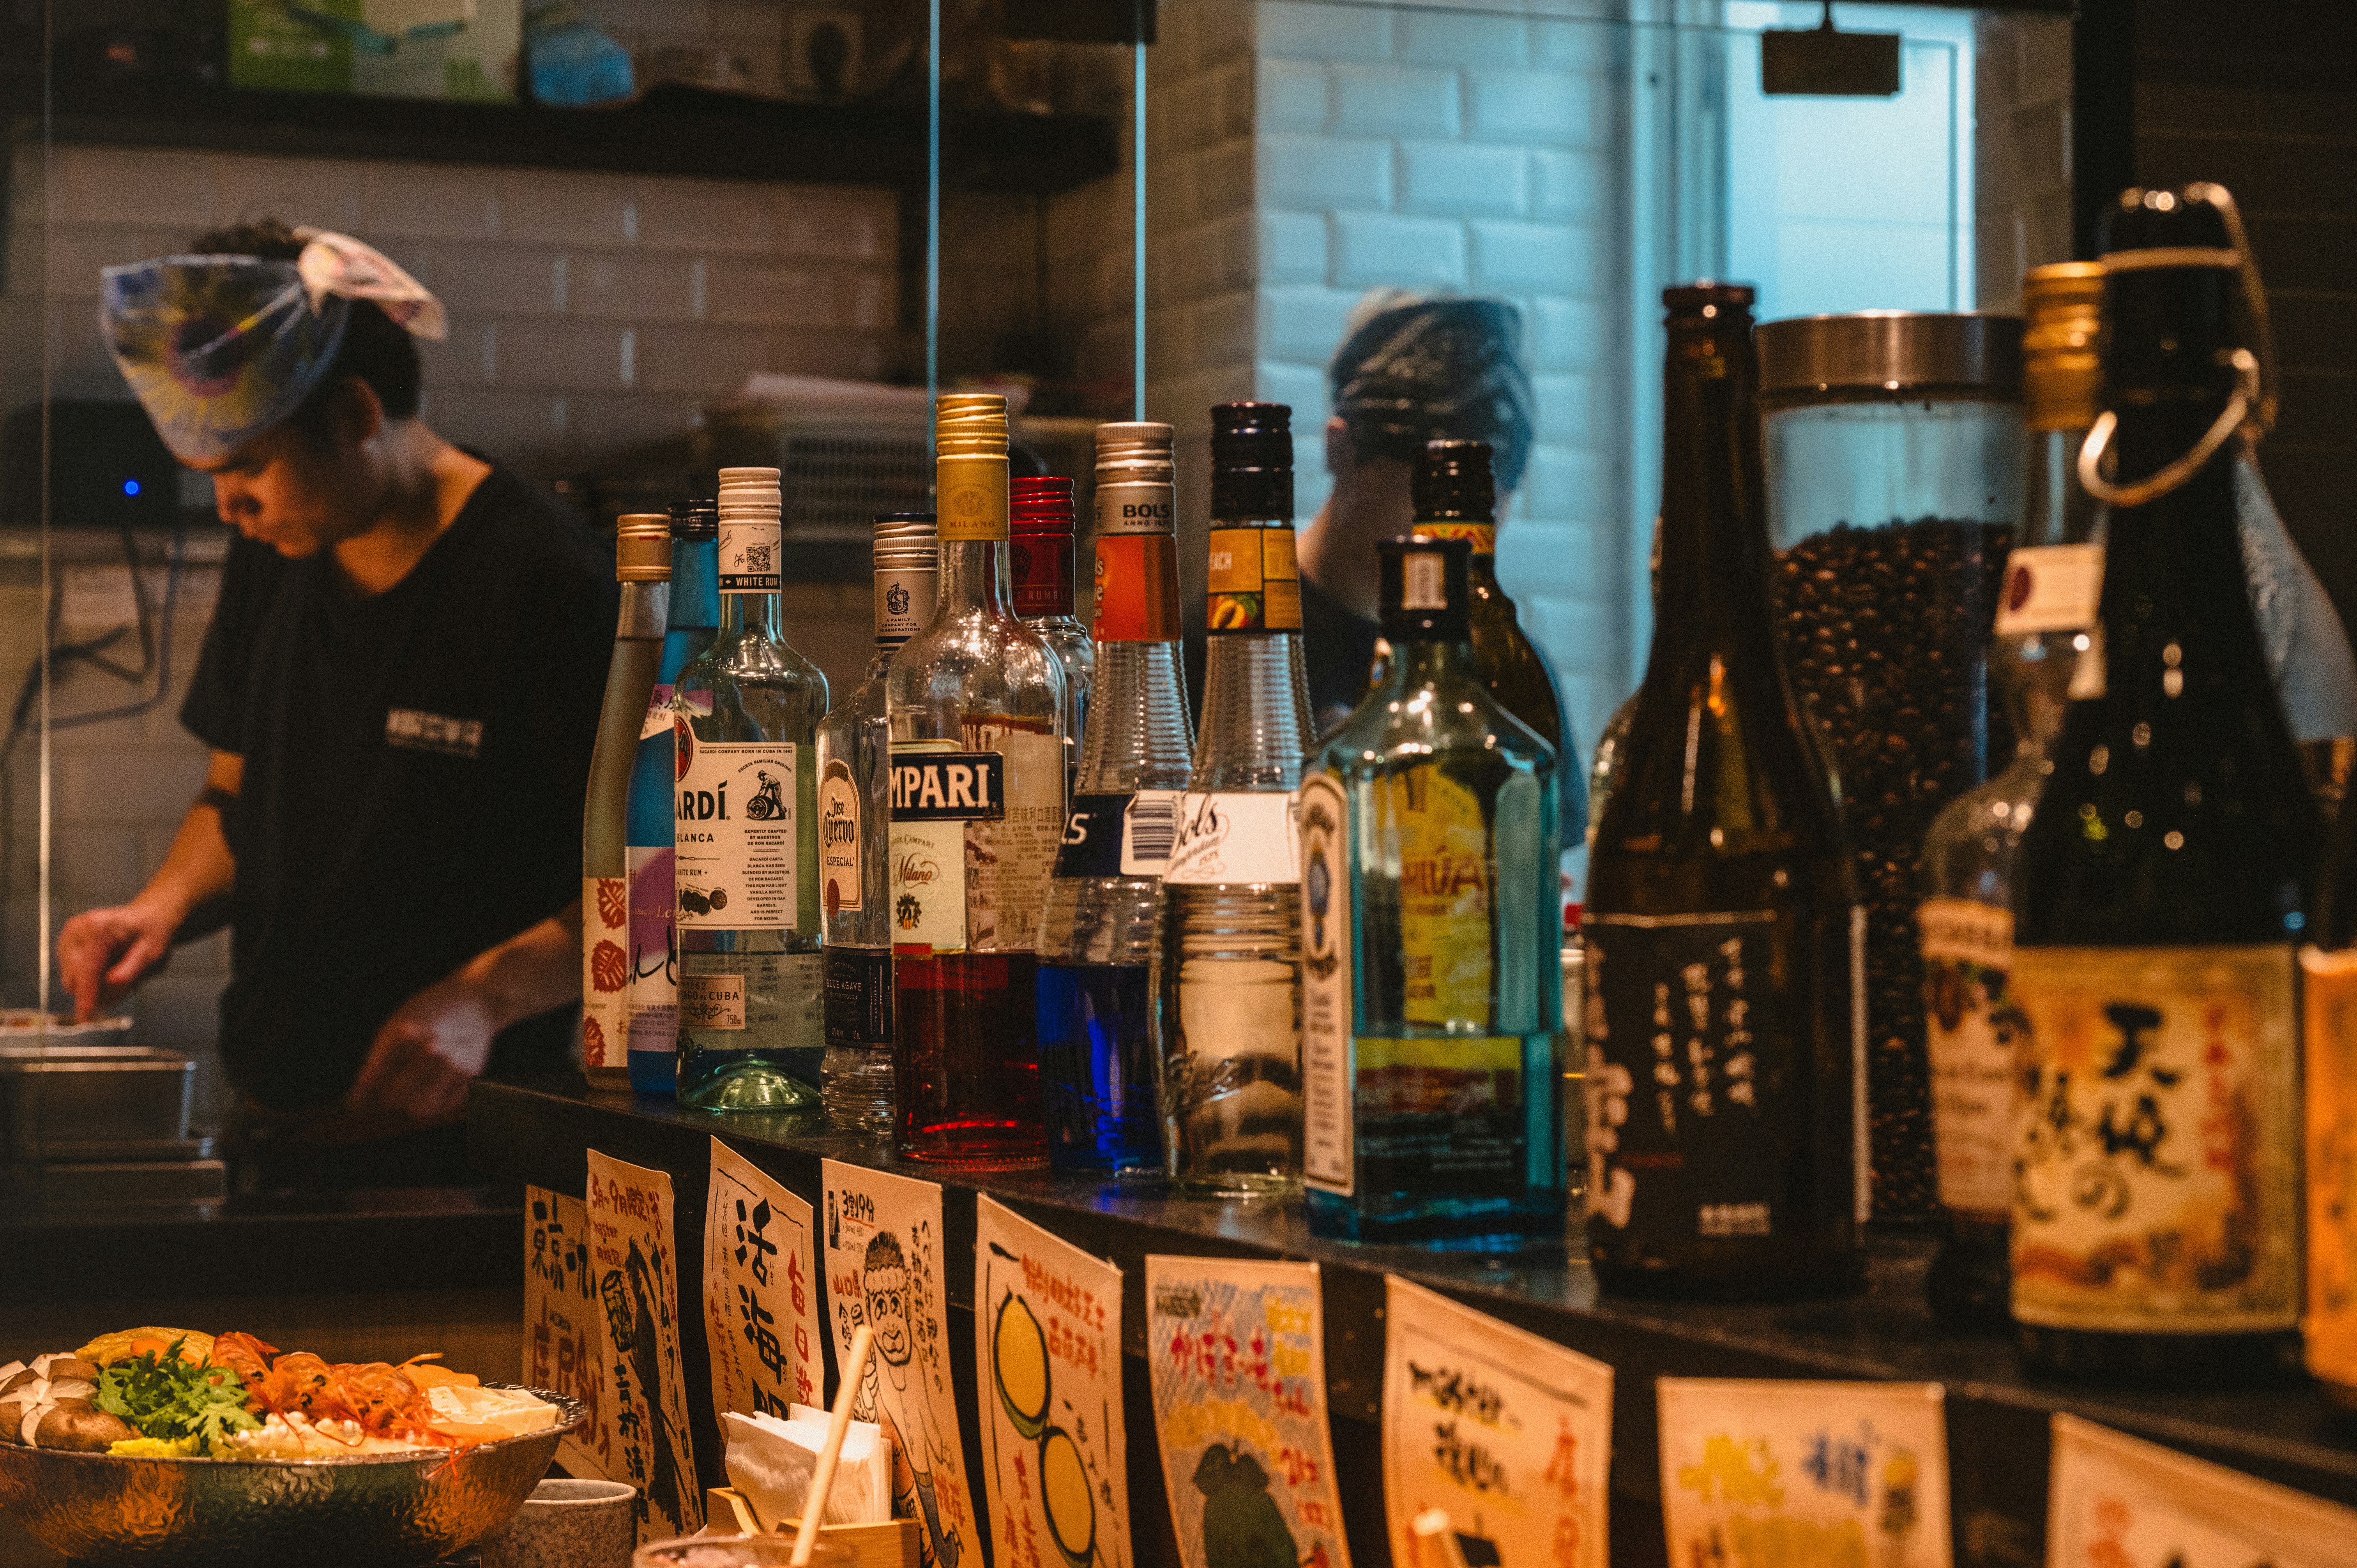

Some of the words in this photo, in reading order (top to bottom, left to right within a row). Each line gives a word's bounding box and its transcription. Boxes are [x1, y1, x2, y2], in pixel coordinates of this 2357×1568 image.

[736, 577, 763, 586] WHITE
[765, 577, 778, 586] RUM
[738, 762, 753, 773] RECETA
[774, 760, 792, 773] ORIGINAL
[831, 797, 844, 819] Jose
[823, 810, 854, 848] Cuervo
[827, 856, 854, 867] ESPECIAL
[826, 978, 840, 989] BLUE
[841, 981, 862, 992] AGAVE
[709, 991, 739, 1000] CUBA
